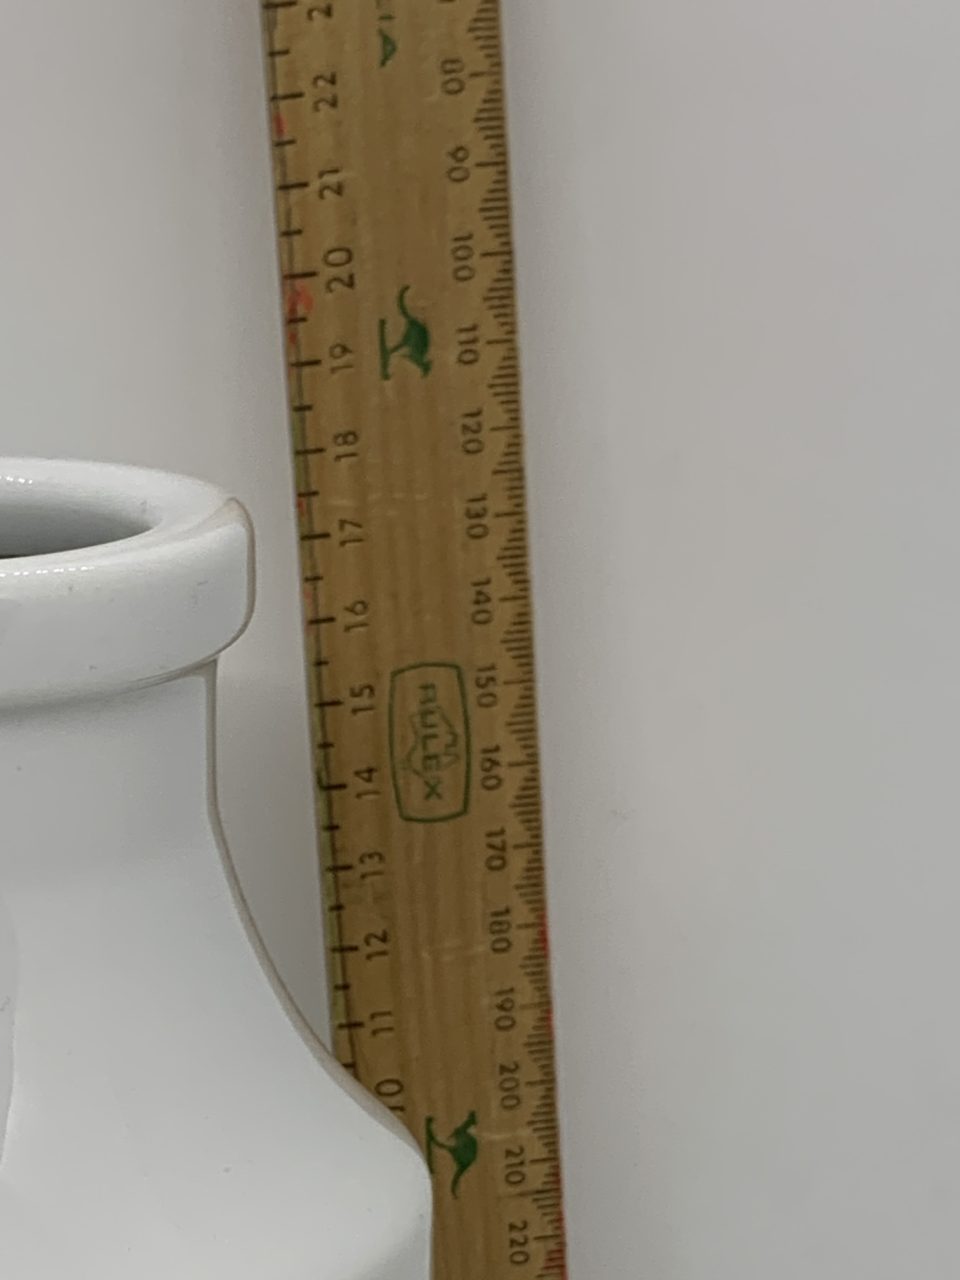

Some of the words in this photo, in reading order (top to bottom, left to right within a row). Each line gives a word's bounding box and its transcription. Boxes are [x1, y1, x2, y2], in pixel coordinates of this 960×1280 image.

[312, 72, 338, 112] 22
[440, 58, 466, 96] 80
[318, 169, 343, 200] 21
[445, 145, 471, 183] 90
[323, 247, 356, 293] 20
[450, 232, 475, 282] 100
[329, 344, 353, 374] 19
[456, 324, 480, 366] 110
[333, 430, 359, 462] 18
[460, 407, 485, 455] 120
[338, 519, 363, 548] 17
[464, 493, 490, 540] 130
[343, 600, 370, 633] 16
[471, 578, 493, 626] 140
[350, 683, 376, 716] 15
[475, 663, 499, 709] 150
[417, 682, 444, 800] RULEX
[354, 766, 381, 799] 14
[480, 744, 503, 791] 160
[359, 851, 384, 881] 13
[485, 827, 507, 872] 170
[364, 929, 390, 962] 12
[489, 906, 513, 953] 180
[370, 1010, 394, 1037] 11
[494, 986, 516, 1032] 190
[498, 1061, 521, 1111] 200
[504, 1146, 526, 1187] 210
[508, 1220, 530, 1266] 220
